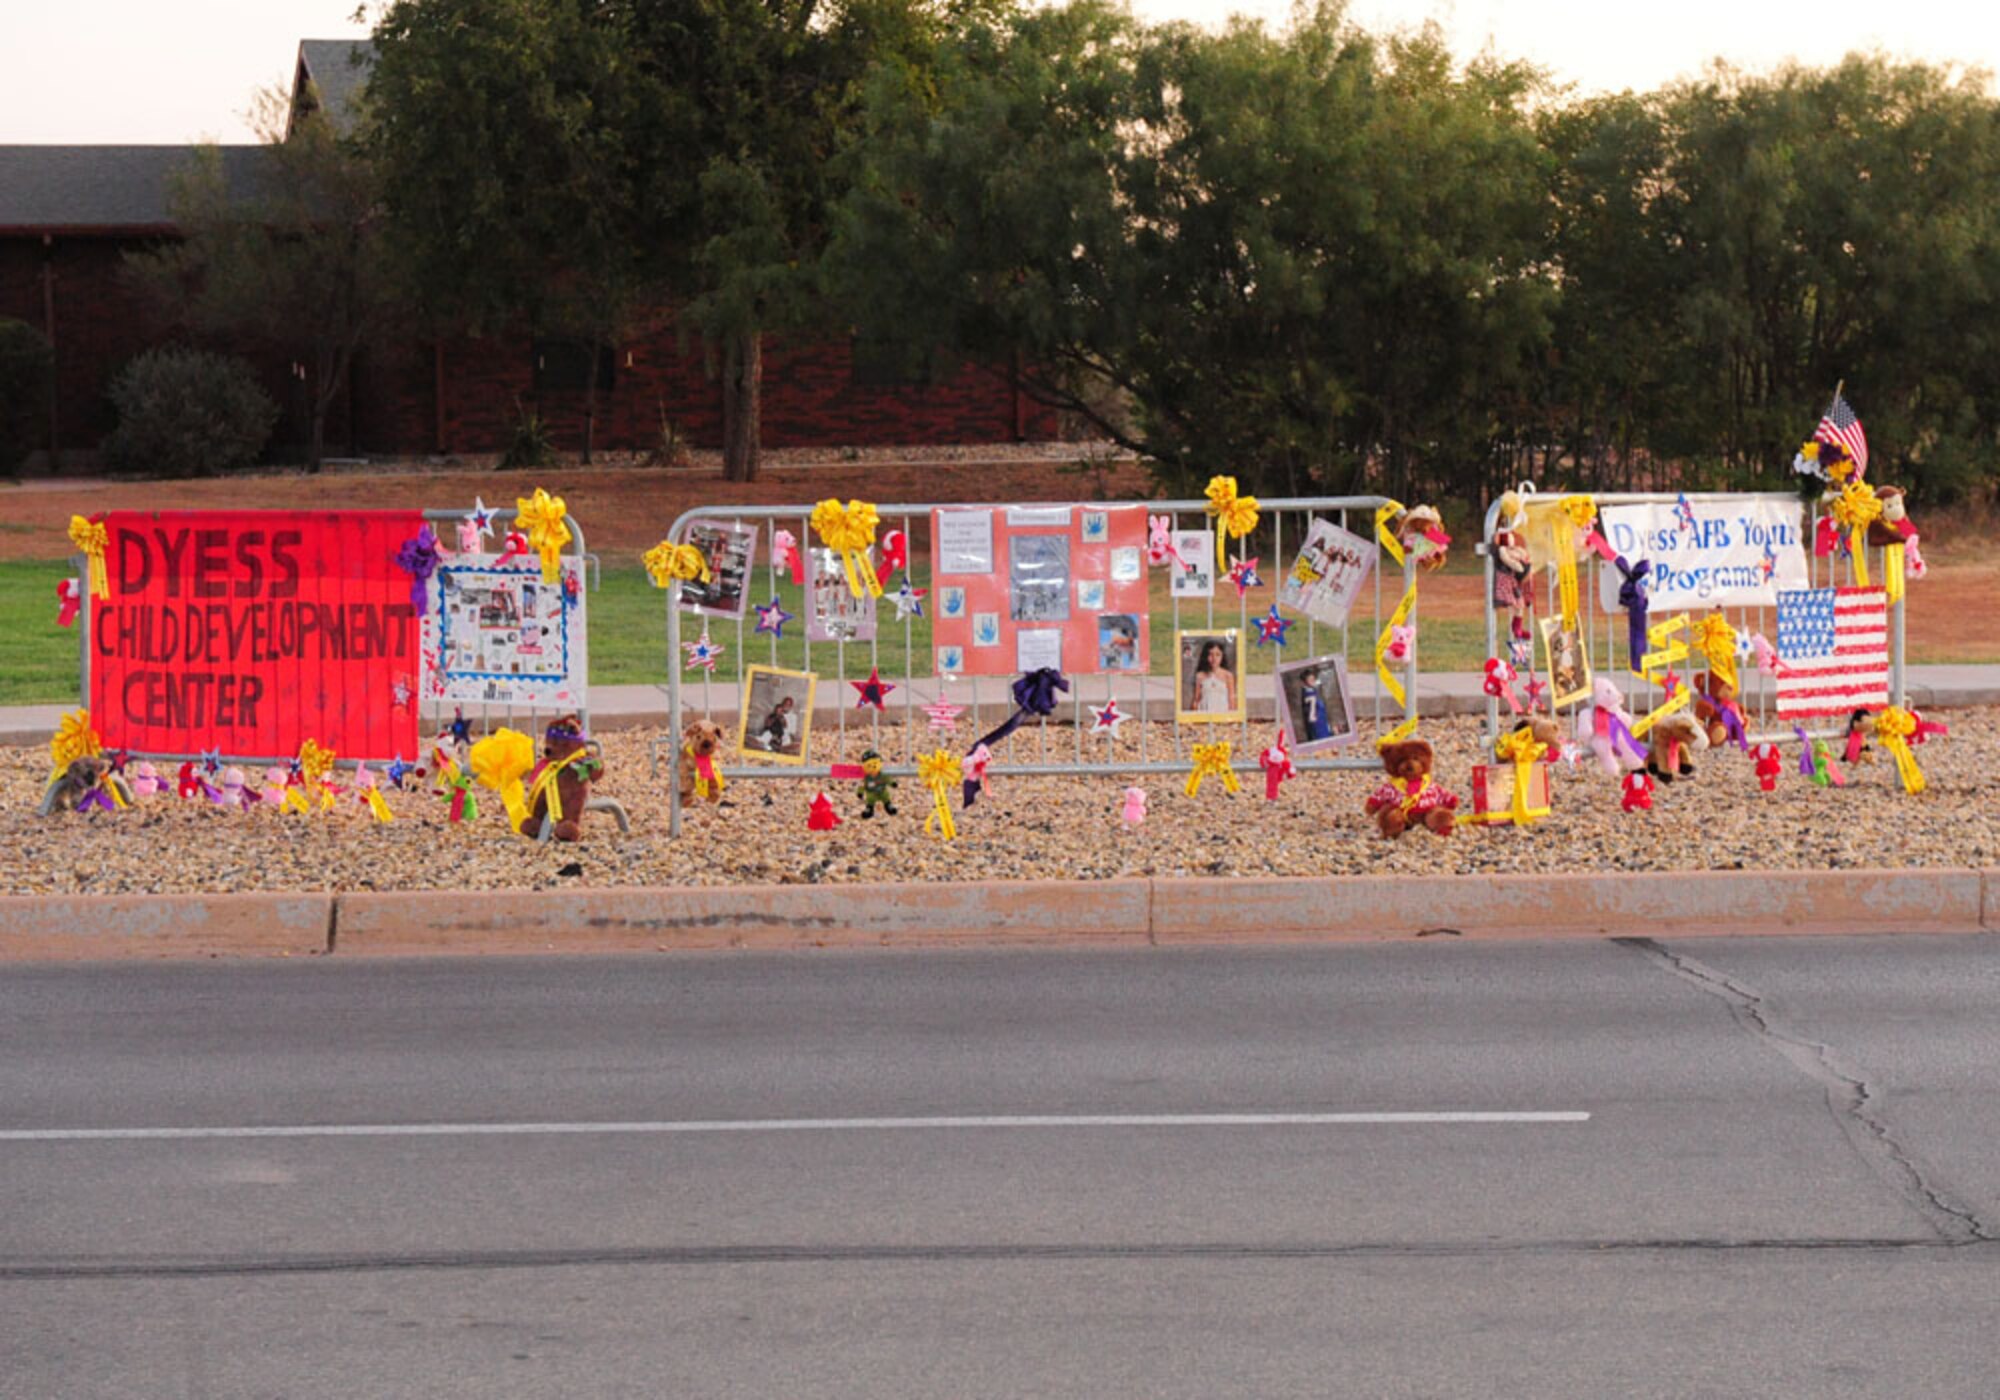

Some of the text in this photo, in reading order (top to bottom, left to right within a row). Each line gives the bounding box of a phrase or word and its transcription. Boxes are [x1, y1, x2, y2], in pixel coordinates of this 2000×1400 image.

[117, 527, 302, 598] DYESS
[1687, 518, 1731, 549] AFB
[1655, 563, 1760, 598] Programs
[97, 601, 415, 663] CHILD DEVELOPMENT
[122, 670, 263, 729] CENTER
